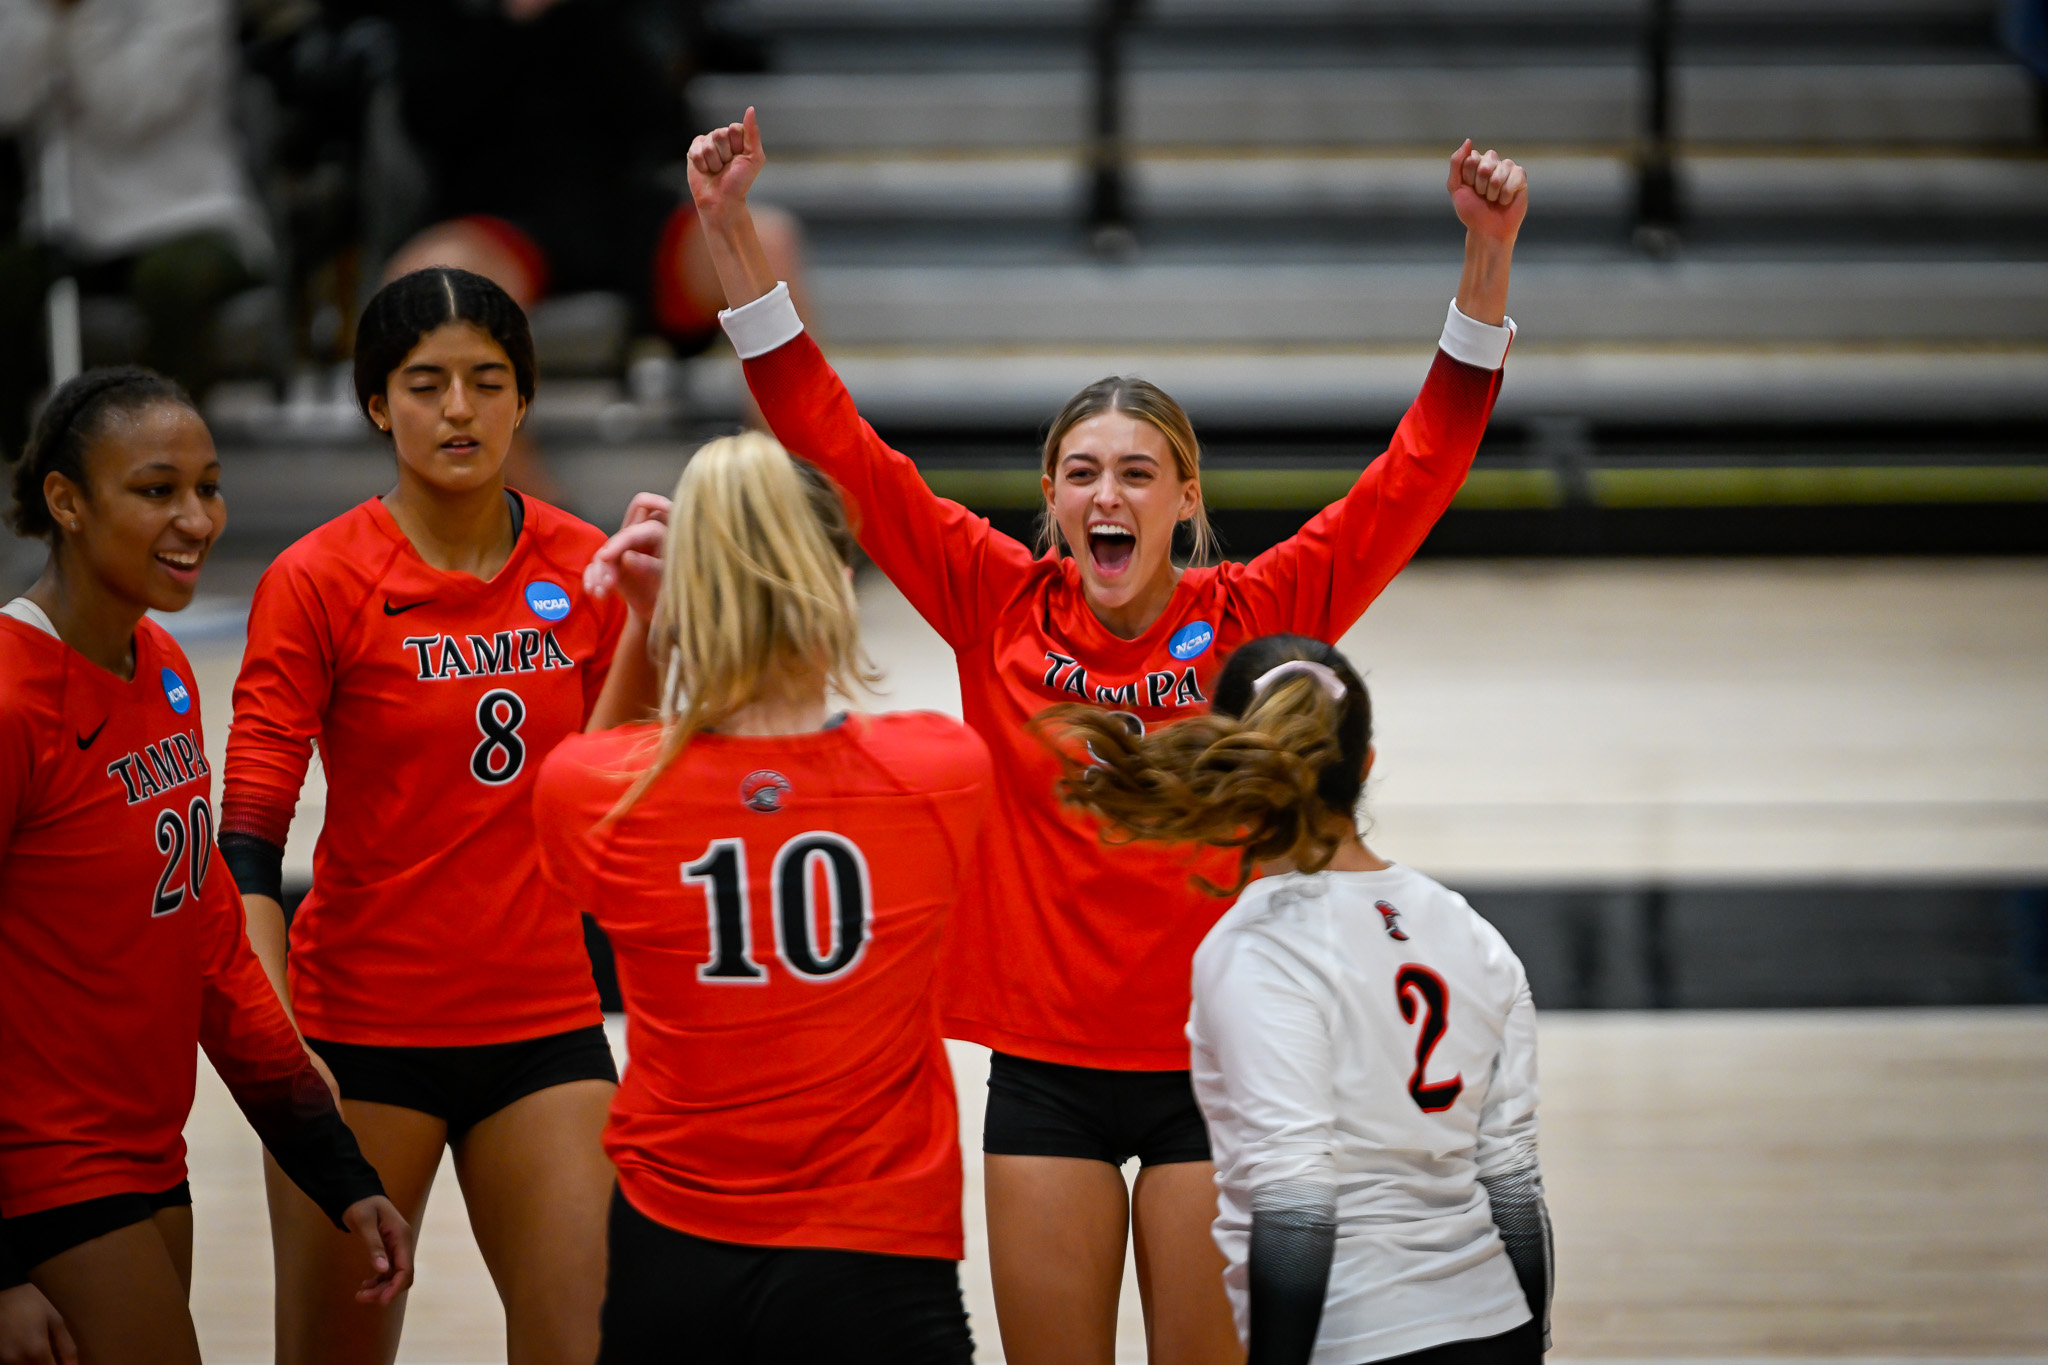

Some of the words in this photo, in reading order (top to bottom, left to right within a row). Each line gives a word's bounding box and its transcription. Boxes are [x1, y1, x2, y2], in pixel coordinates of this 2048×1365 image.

[533, 598, 569, 610] NCAA
[1175, 631, 1211, 653] NCAA
[403, 628, 574, 681] TAMPA
[1043, 650, 1208, 707] TAMPA
[107, 729, 209, 805] TAMPA
[470, 688, 526, 785] 8
[151, 795, 212, 918] 20
[680, 830, 874, 983] 10
[1395, 962, 1464, 1113] 2
